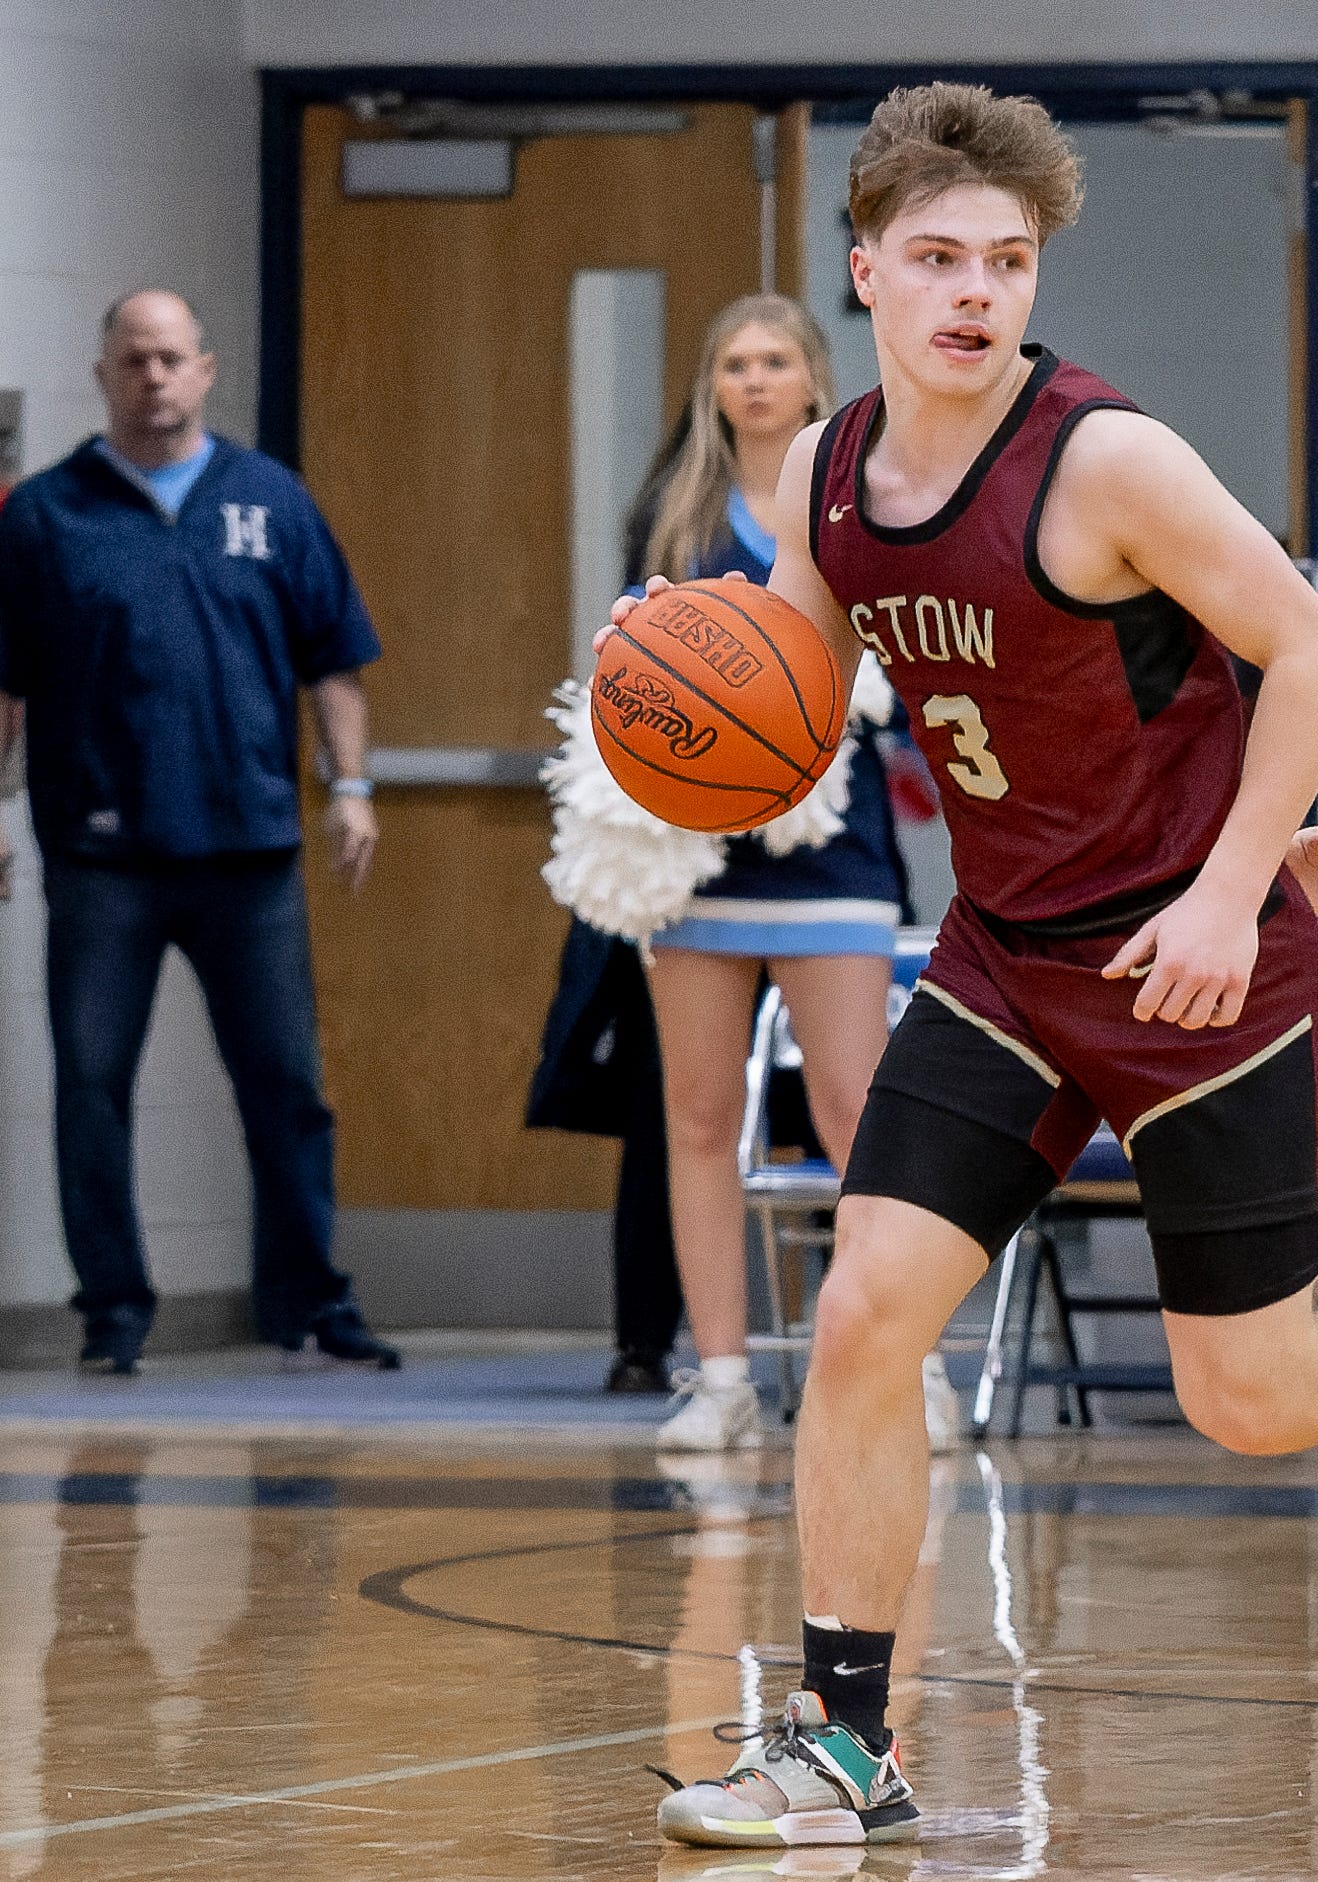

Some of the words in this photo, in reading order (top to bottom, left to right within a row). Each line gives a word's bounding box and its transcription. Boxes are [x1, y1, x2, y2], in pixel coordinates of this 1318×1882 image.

[220, 503, 272, 559] H
[850, 594, 996, 669] STOW
[921, 694, 1010, 801] 3
